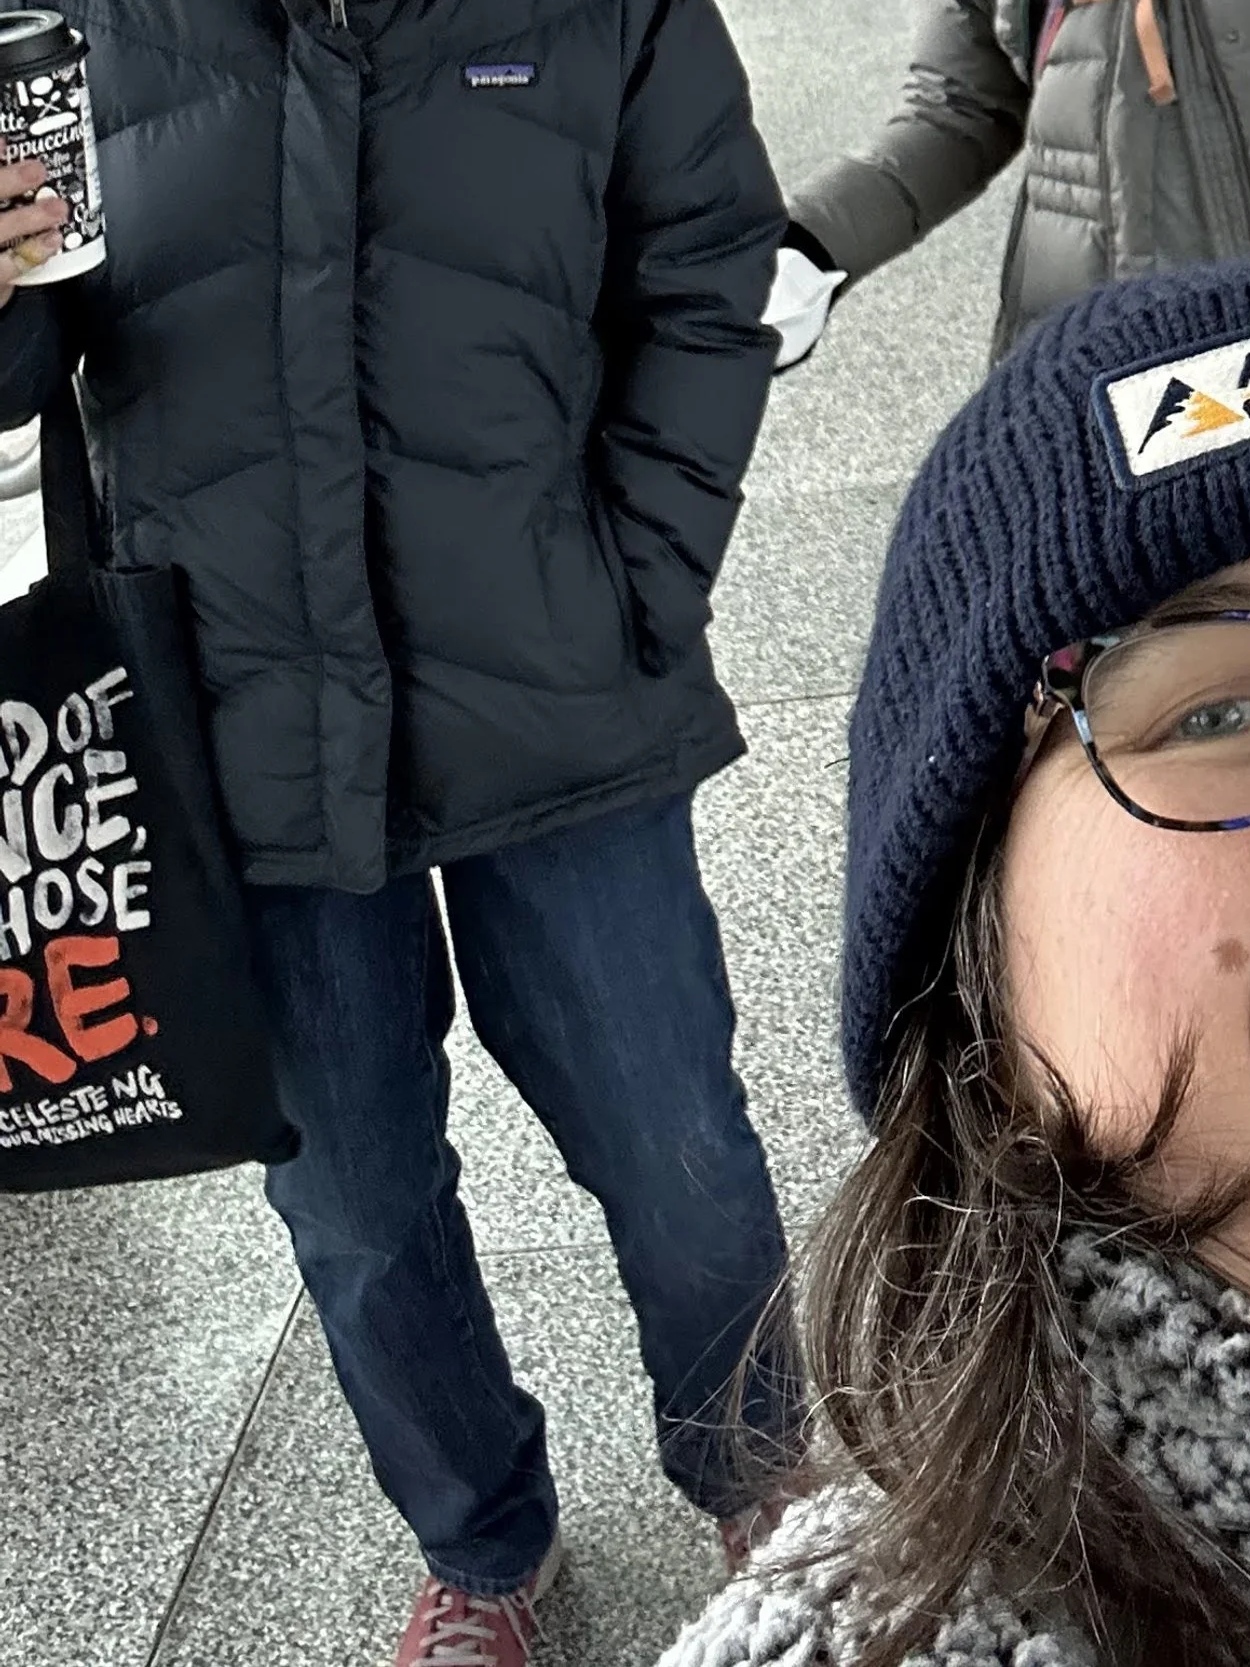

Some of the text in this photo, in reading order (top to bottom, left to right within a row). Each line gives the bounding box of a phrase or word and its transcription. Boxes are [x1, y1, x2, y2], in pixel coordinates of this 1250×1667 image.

[57, 666, 134, 754] OF
[0, 1063, 166, 1133] CELESTE NG
[37, 1113, 115, 1145] MISSING
[112, 1098, 183, 1126] HEARTS
